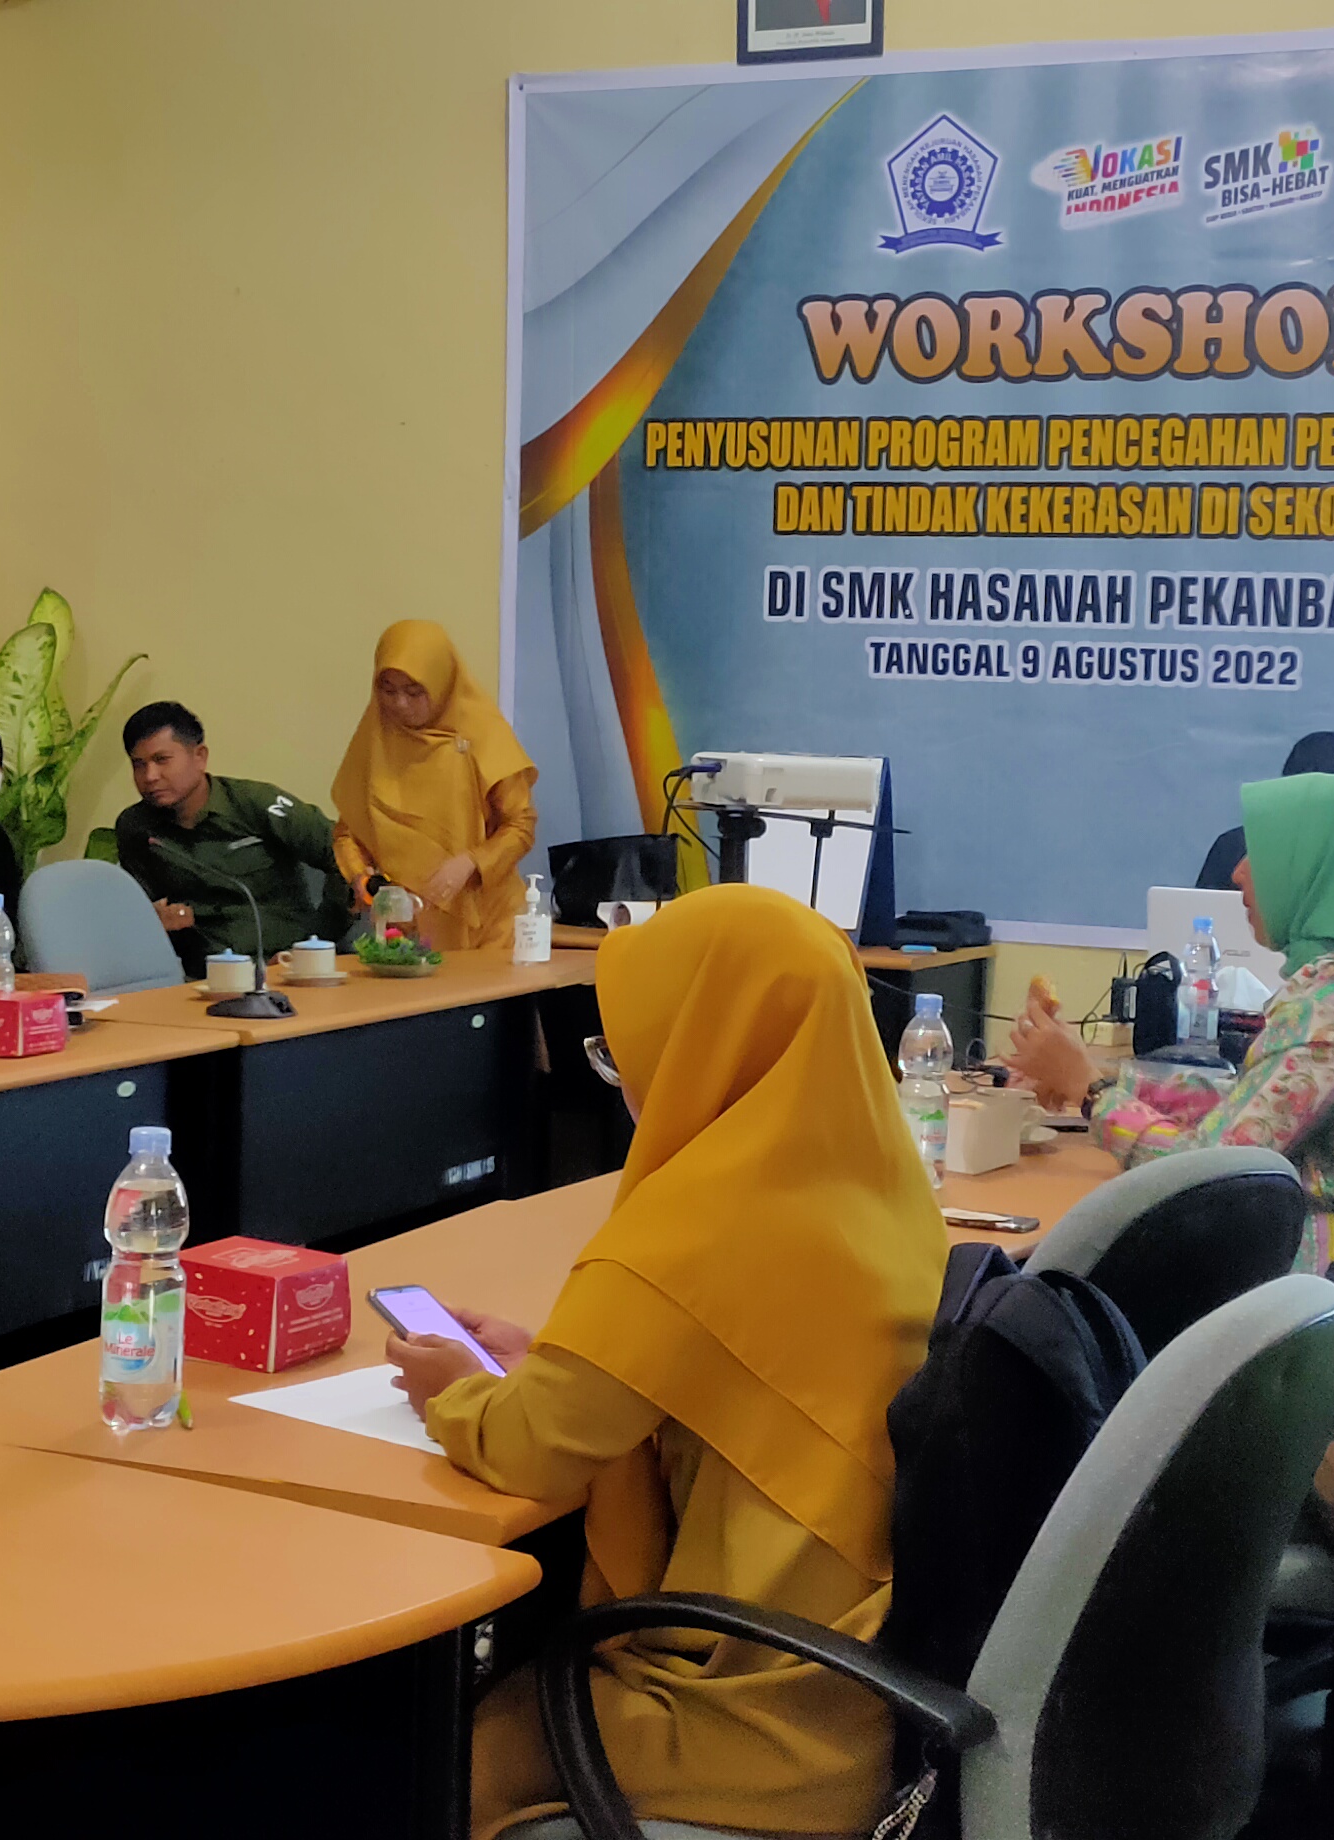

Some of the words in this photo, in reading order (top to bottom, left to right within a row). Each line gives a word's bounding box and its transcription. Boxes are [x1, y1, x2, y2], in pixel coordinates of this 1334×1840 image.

[1064, 136, 1182, 182] VOKASI
[1101, 165, 1179, 192] MENGUATKAN
[1204, 142, 1273, 190] SMK
[1221, 166, 1329, 207] BISA-HEBAT
[645, 418, 861, 468] PENYUSUNAN
[868, 418, 1040, 468] PROGRAM
[1048, 416, 1285, 468] PENCEGAHAN
[777, 485, 845, 532] DAN
[852, 485, 980, 534] TINDAK
[985, 486, 1192, 536] KEKERASAN
[1200, 487, 1240, 537] DI
[768, 571, 805, 617] DI
[822, 572, 914, 620] SMK
[930, 573, 1132, 625] HASANAH
[870, 642, 1010, 678] TANGGAL
[1022, 644, 1038, 678] 9
[1052, 646, 1200, 683] AGUSTUS
[1211, 650, 1299, 686] 2022
[104, 1342, 156, 1358] Minerale
[118, 1330, 133, 1345] Le
